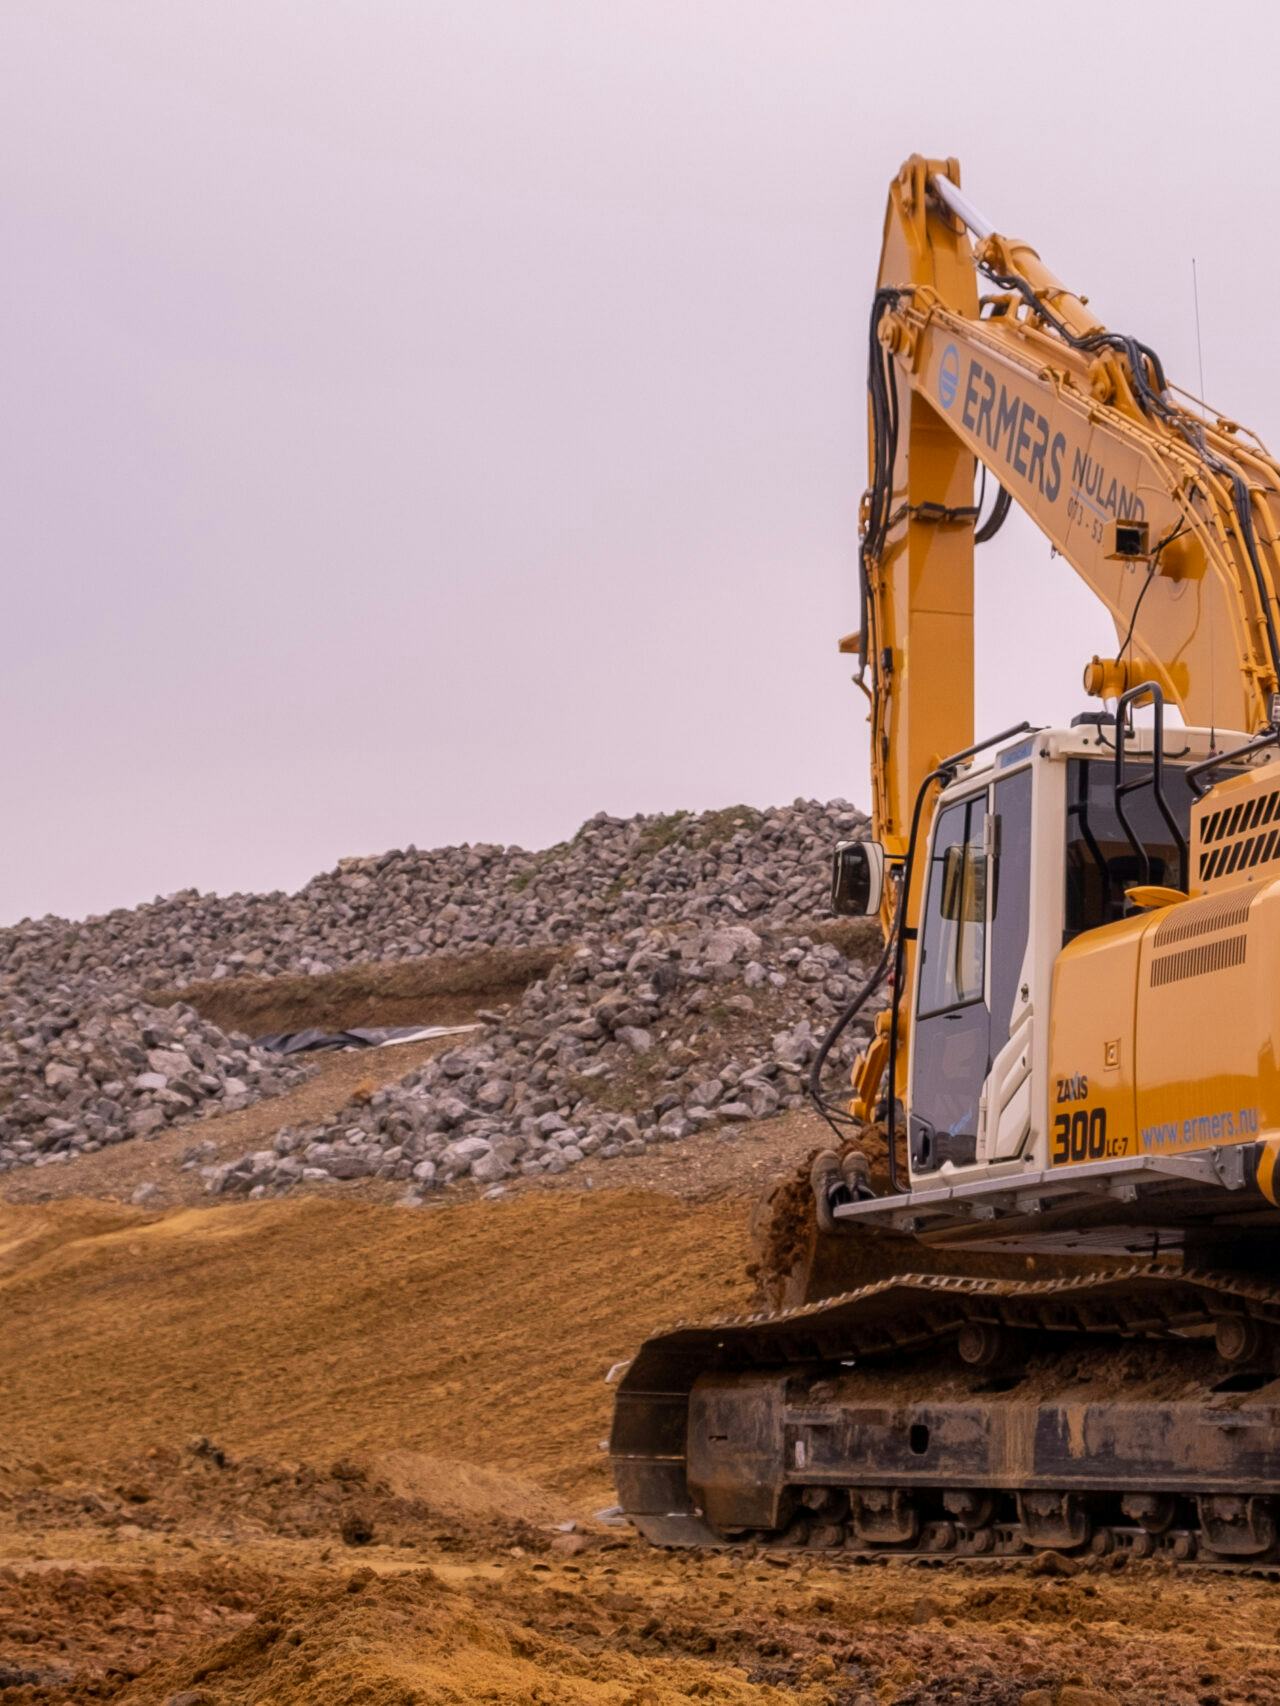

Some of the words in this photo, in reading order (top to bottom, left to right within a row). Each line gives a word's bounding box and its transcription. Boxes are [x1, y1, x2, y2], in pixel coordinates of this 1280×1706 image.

[962, 358, 1066, 503] ERMERS
[1072, 446, 1145, 521] NULAND
[1056, 1072, 1088, 1104] ZAXIS
[1053, 1107, 1107, 1165] 300
[1141, 1107, 1259, 1149] www.ermers.nu
